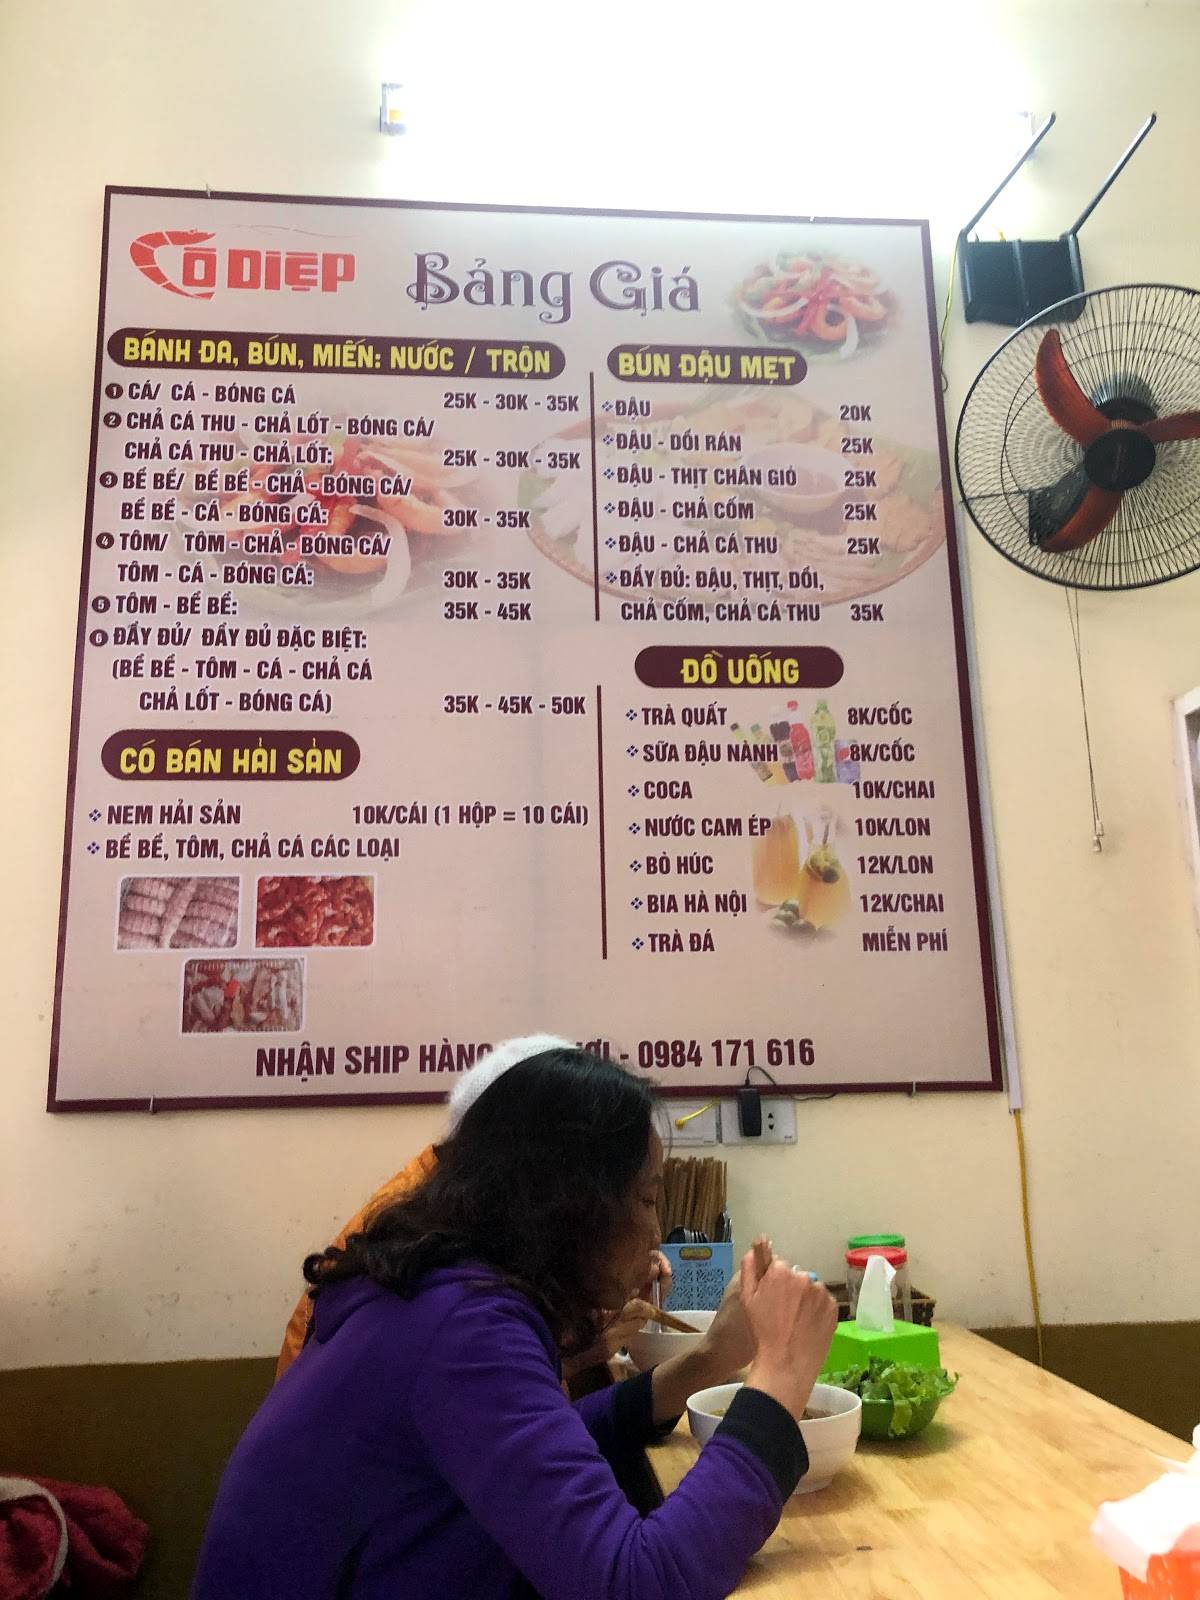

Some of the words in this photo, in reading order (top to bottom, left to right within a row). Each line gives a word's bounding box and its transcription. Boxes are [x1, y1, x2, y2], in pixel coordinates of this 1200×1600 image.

[406, 252, 573, 324] Bảng
[590, 260, 701, 317] Giá
[123, 331, 191, 363] BÁNH
[198, 337, 238, 366] ĐA,
[248, 335, 304, 369] BÚN,
[313, 338, 381, 369] MIẾN:
[390, 339, 454, 371] NƯỚC
[486, 345, 550, 378] TRỘN
[618, 345, 670, 377] BÚN
[679, 350, 731, 383] ĐẬU
[741, 355, 795, 384] MẸT
[128, 380, 161, 400] CÁ/
[171, 382, 195, 401] CÁ
[215, 383, 265, 403] BÓNG
[271, 384, 295, 404] CÁ
[444, 392, 477, 409] 25K
[495, 394, 528, 410] 30K
[547, 395, 579, 411] 35K
[615, 396, 650, 420] ĐẬU
[840, 405, 871, 421] 20K
[127, 408, 164, 430] CHẢ
[170, 411, 194, 431] CÁ
[201, 415, 235, 431] THU
[255, 411, 291, 433] CHẢ
[297, 412, 329, 433] LỐT
[348, 416, 397, 435] BÓNG
[403, 417, 435, 437] CÁ/
[125, 437, 162, 459] CHẢ
[169, 439, 193, 460] CÁ
[200, 444, 234, 461] THU
[254, 441, 290, 462] CHẢ
[296, 441, 332, 463] LỐT:
[444, 450, 477, 466] 25K
[495, 451, 529, 468] 30K
[548, 452, 580, 469] 35K
[616, 430, 651, 453] ĐẬU
[705, 432, 741, 451] RÁN
[842, 438, 873, 453] 25K
[617, 463, 652, 487] ĐẬU
[672, 468, 707, 488] THỊT
[714, 465, 762, 485] CHÂN
[845, 471, 876, 487] 25K
[444, 510, 477, 526] 30K
[496, 511, 530, 528] 35K
[618, 496, 654, 522] ĐẬU
[672, 496, 710, 519] CHẢ
[714, 496, 754, 520] CỐM
[845, 504, 877, 520] 25K
[119, 530, 168, 551] TÔM/
[185, 530, 225, 552] TÔM
[244, 529, 283, 554] CHẢ
[301, 533, 352, 555] BÓNG
[359, 532, 390, 556] CÁ/
[619, 532, 655, 556] ĐẬU
[674, 530, 709, 553] CHẢ
[716, 533, 739, 554] CÁ
[745, 537, 778, 554] THU
[847, 538, 880, 554] 25K
[118, 561, 158, 582] TÔM
[179, 562, 204, 583] CÁ
[224, 564, 275, 584] BÓNG
[282, 564, 313, 585] CÁ:
[444, 571, 478, 588] 30K
[497, 572, 531, 589] 35K
[661, 565, 690, 588] ĐỦ:
[696, 567, 737, 592] ĐẬU,
[743, 571, 783, 592] THỊT,
[444, 602, 478, 620] 35K
[497, 603, 531, 620] 45K
[621, 597, 657, 620] CHẢ
[663, 597, 709, 623] CỐM,
[716, 597, 751, 621] CHẢ
[757, 601, 781, 621] CÁ
[787, 604, 820, 621] THU
[851, 604, 884, 621] 35K
[158, 622, 191, 646] ĐỦ/
[246, 623, 271, 647] ĐỦ
[278, 626, 315, 651] ĐẶC
[322, 627, 367, 652] BIỆT:
[196, 656, 236, 679] TÔM
[257, 658, 282, 679] CÁ
[302, 657, 340, 680] CHẢ
[347, 659, 372, 680] CÁ
[680, 650, 723, 684] ĐỒ
[728, 652, 799, 684] UỐNG
[140, 686, 179, 710] CHẢ
[185, 685, 219, 711] LỐT
[240, 689, 292, 712] BÓNG
[299, 690, 331, 713] CÁ)
[444, 696, 479, 713] 35K
[499, 696, 532, 714] 45K
[551, 697, 585, 714] 50K
[642, 704, 675, 725] TRÀ
[682, 701, 727, 727] QUẤT
[848, 701, 912, 725] 8K/CỐC
[120, 739, 156, 774] CÓ
[166, 739, 222, 774] BÁN
[232, 737, 277, 774] HẢI
[287, 737, 342, 774] SẢN
[643, 740, 679, 762] SỮA
[685, 740, 721, 766] ĐẬU
[728, 740, 778, 762] NÀNH
[850, 738, 915, 762] 8K/CỐC
[644, 781, 692, 799] COCA
[853, 780, 935, 799] 10K/CHAI
[108, 805, 153, 825] NEM
[159, 799, 193, 825] HẢI
[199, 798, 241, 824] SẢN
[353, 801, 427, 825] 10K/CÁI
[435, 805, 450, 826] (1
[458, 801, 496, 828] HỘP
[522, 805, 544, 824] 10
[551, 801, 589, 826] CÁI)
[645, 815, 695, 837] NƯỚC
[701, 818, 742, 836] CAM
[749, 815, 771, 836] ÉP
[855, 818, 930, 836] 10K/LON
[176, 835, 224, 860] TÔM,
[231, 832, 271, 858] CHẢ
[278, 834, 304, 858] CÁ
[310, 834, 350, 858] CÁC
[357, 838, 399, 861] LOẠI
[646, 851, 671, 874] BÒ
[677, 852, 713, 874] HÚC
[857, 855, 933, 874] 12K/LON
[648, 894, 678, 913] BIA
[685, 890, 709, 913] HÀ
[715, 890, 746, 917] NỘI
[860, 894, 944, 912] 12K/CHAI
[648, 929, 683, 952] TRÀ
[690, 929, 715, 952] ĐÁ
[863, 926, 910, 952] MIỄN
[917, 929, 948, 952] PHÍ
[256, 1041, 335, 1082] NHẬN
[345, 1045, 409, 1074] SHIP
[638, 1040, 702, 1068] 0984
[712, 1039, 755, 1066] 171
[767, 1038, 815, 1066] 616
